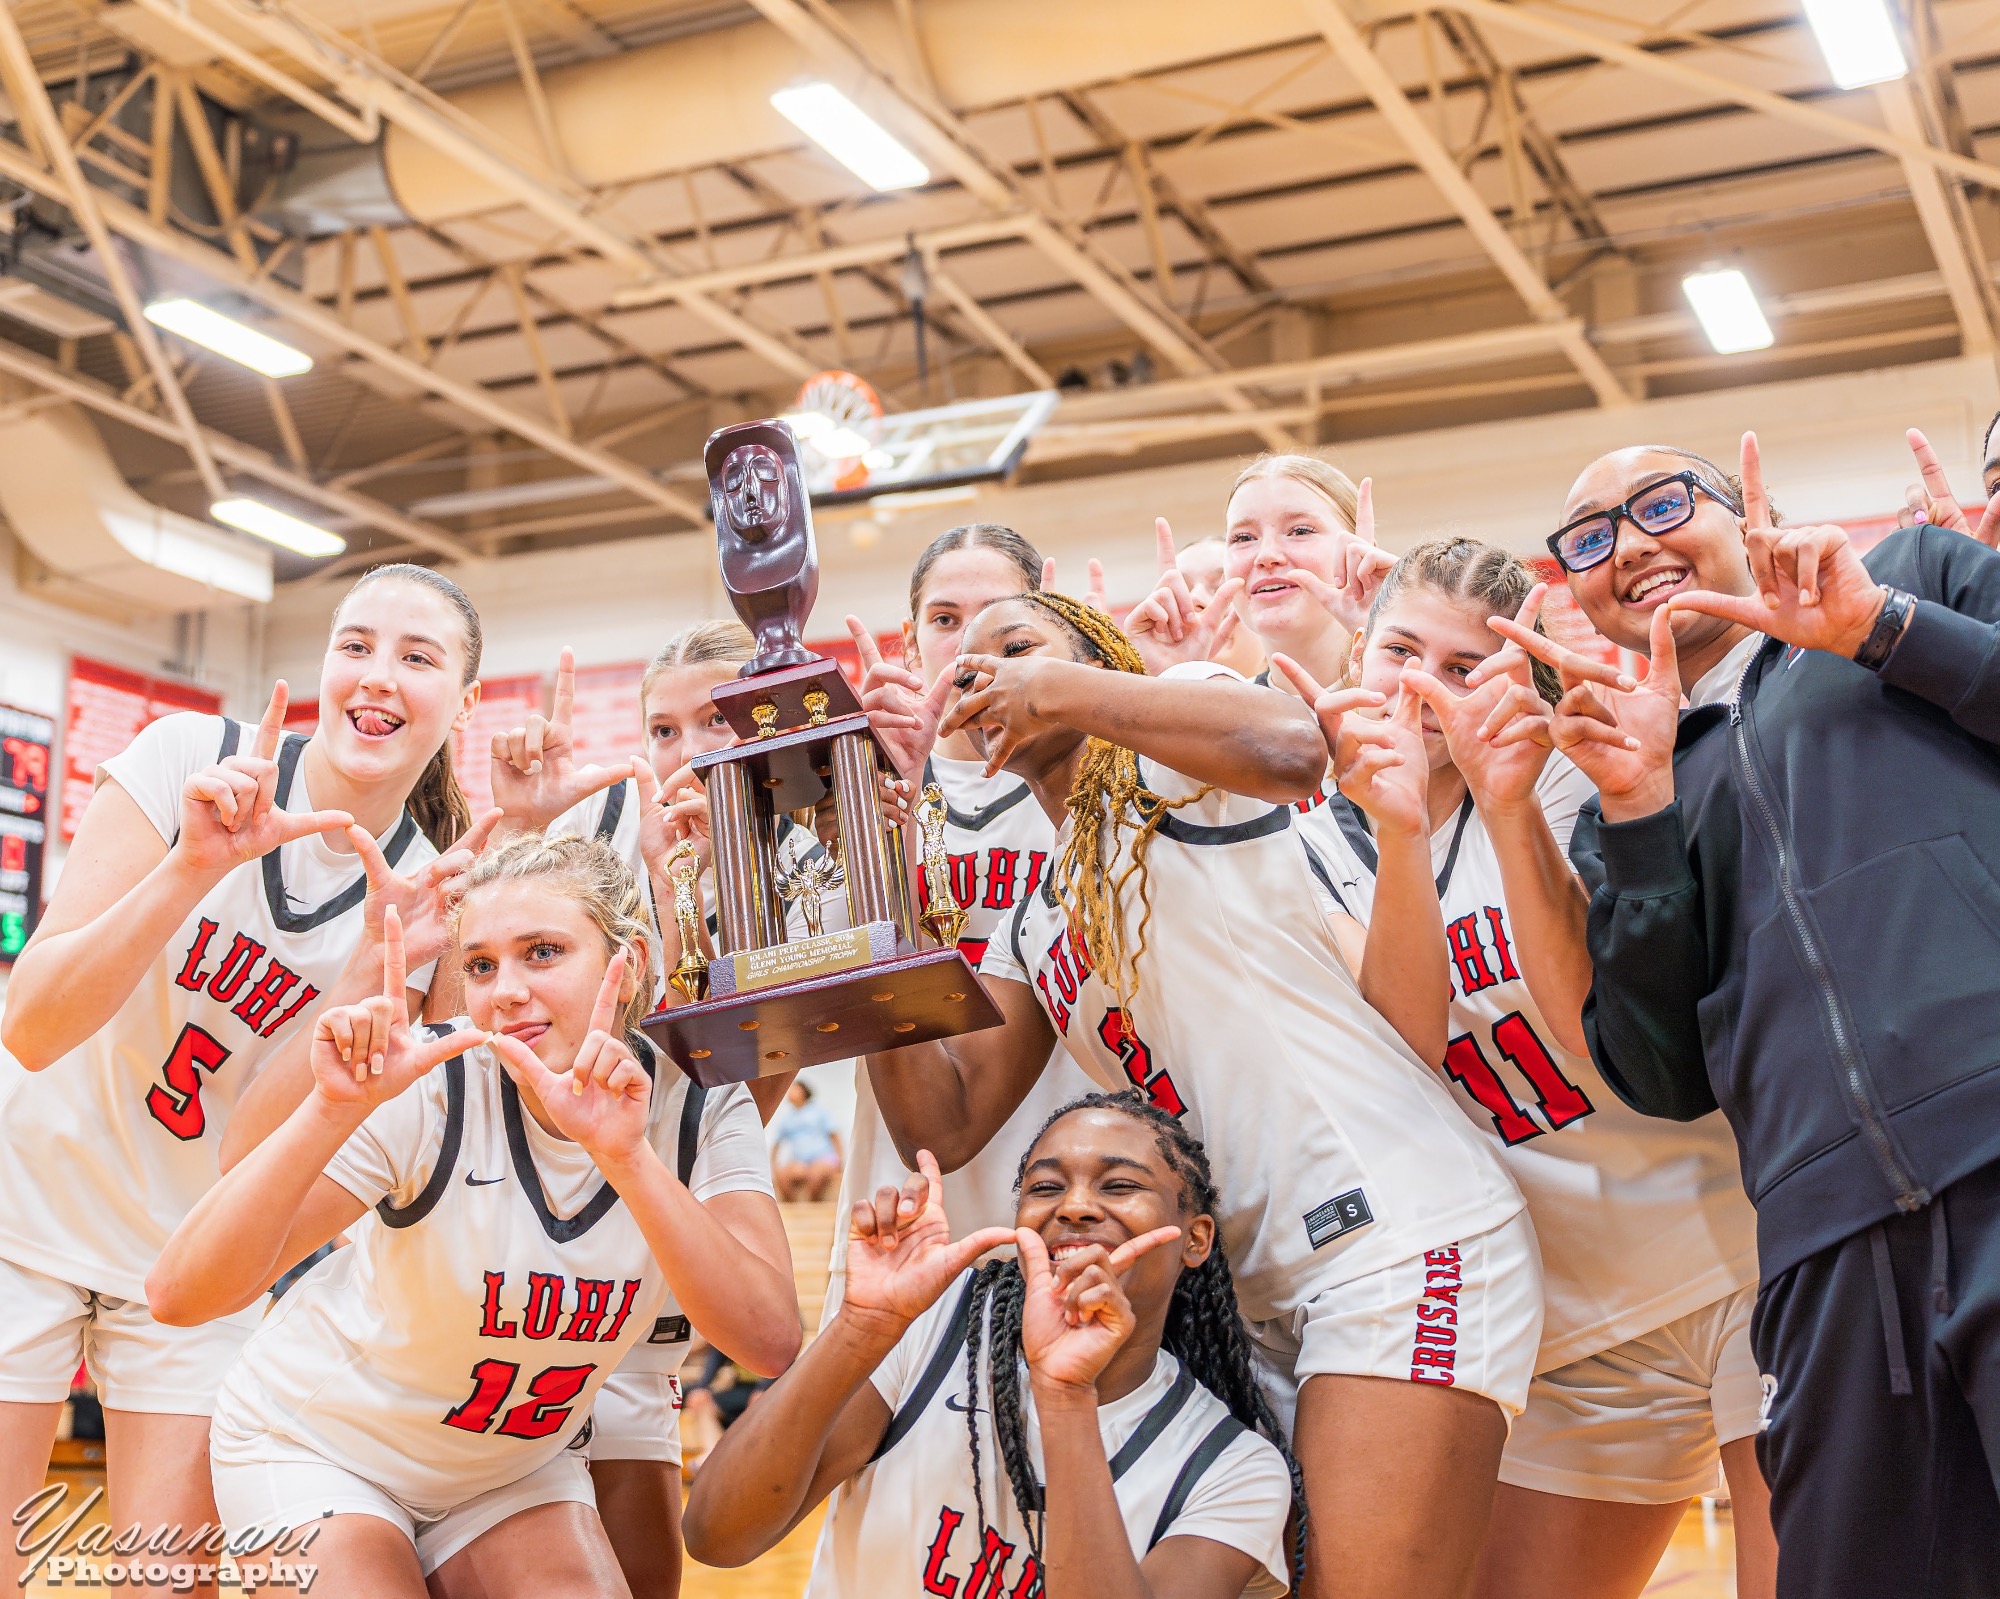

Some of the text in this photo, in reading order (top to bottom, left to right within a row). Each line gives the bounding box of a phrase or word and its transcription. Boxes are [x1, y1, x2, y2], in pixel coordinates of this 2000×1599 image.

[174, 916, 321, 1039] LUHI
[747, 948, 858, 980] GIRLS CHAMPIONSHIP TROPHY
[750, 942, 853, 970] GLENN YOUNG MEMORIAL
[780, 945, 799, 956] PREP
[801, 937, 834, 950] CLASSIC
[145, 1021, 233, 1141] 5
[1442, 1010, 1596, 1148] 11
[1346, 1203, 1358, 1217] S
[479, 1269, 642, 1342] LUHI
[1410, 1241, 1462, 1386] CRUSADE
[440, 1358, 598, 1440] 12
